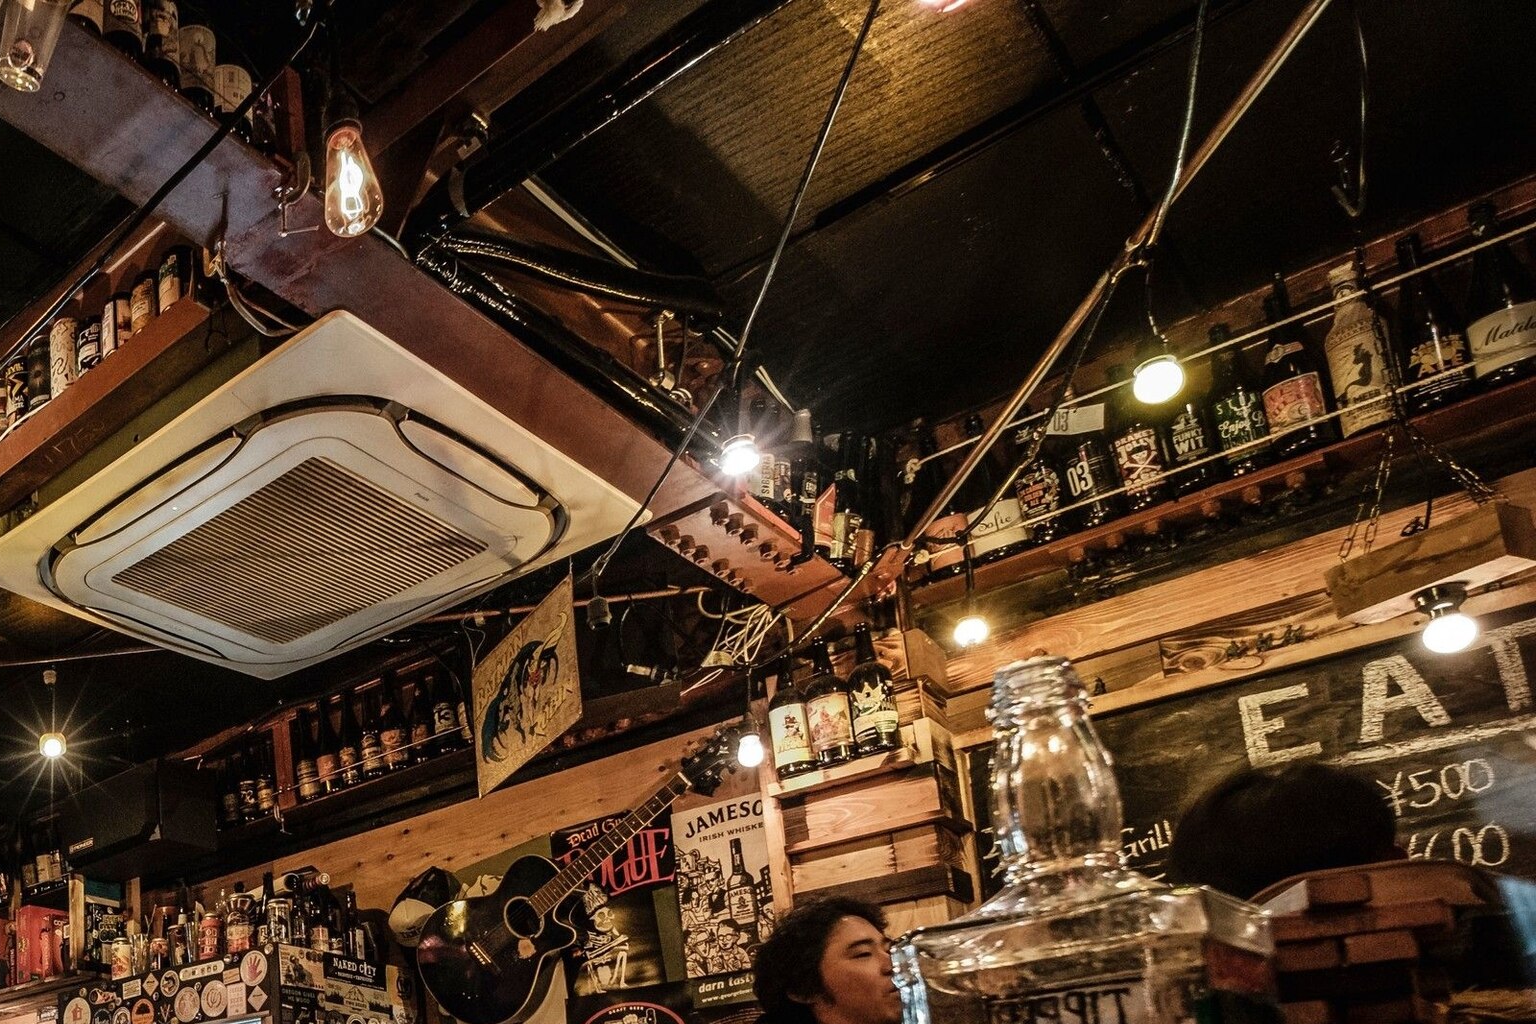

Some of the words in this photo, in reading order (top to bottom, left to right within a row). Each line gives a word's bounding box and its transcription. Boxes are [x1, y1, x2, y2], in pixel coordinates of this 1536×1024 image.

[1172, 428, 1203, 444] FUNKY
[1174, 435, 1205, 455] WIT
[1066, 460, 1094, 497] 03
[1237, 617, 1536, 769] EAT
[566, 823, 600, 848] Dead
[601, 816, 625, 836] Gu
[699, 831, 724, 843] IRISH
[332, 956, 358, 972] NAKED
[359, 961, 377, 978] CITY
[698, 978, 725, 995] darn
